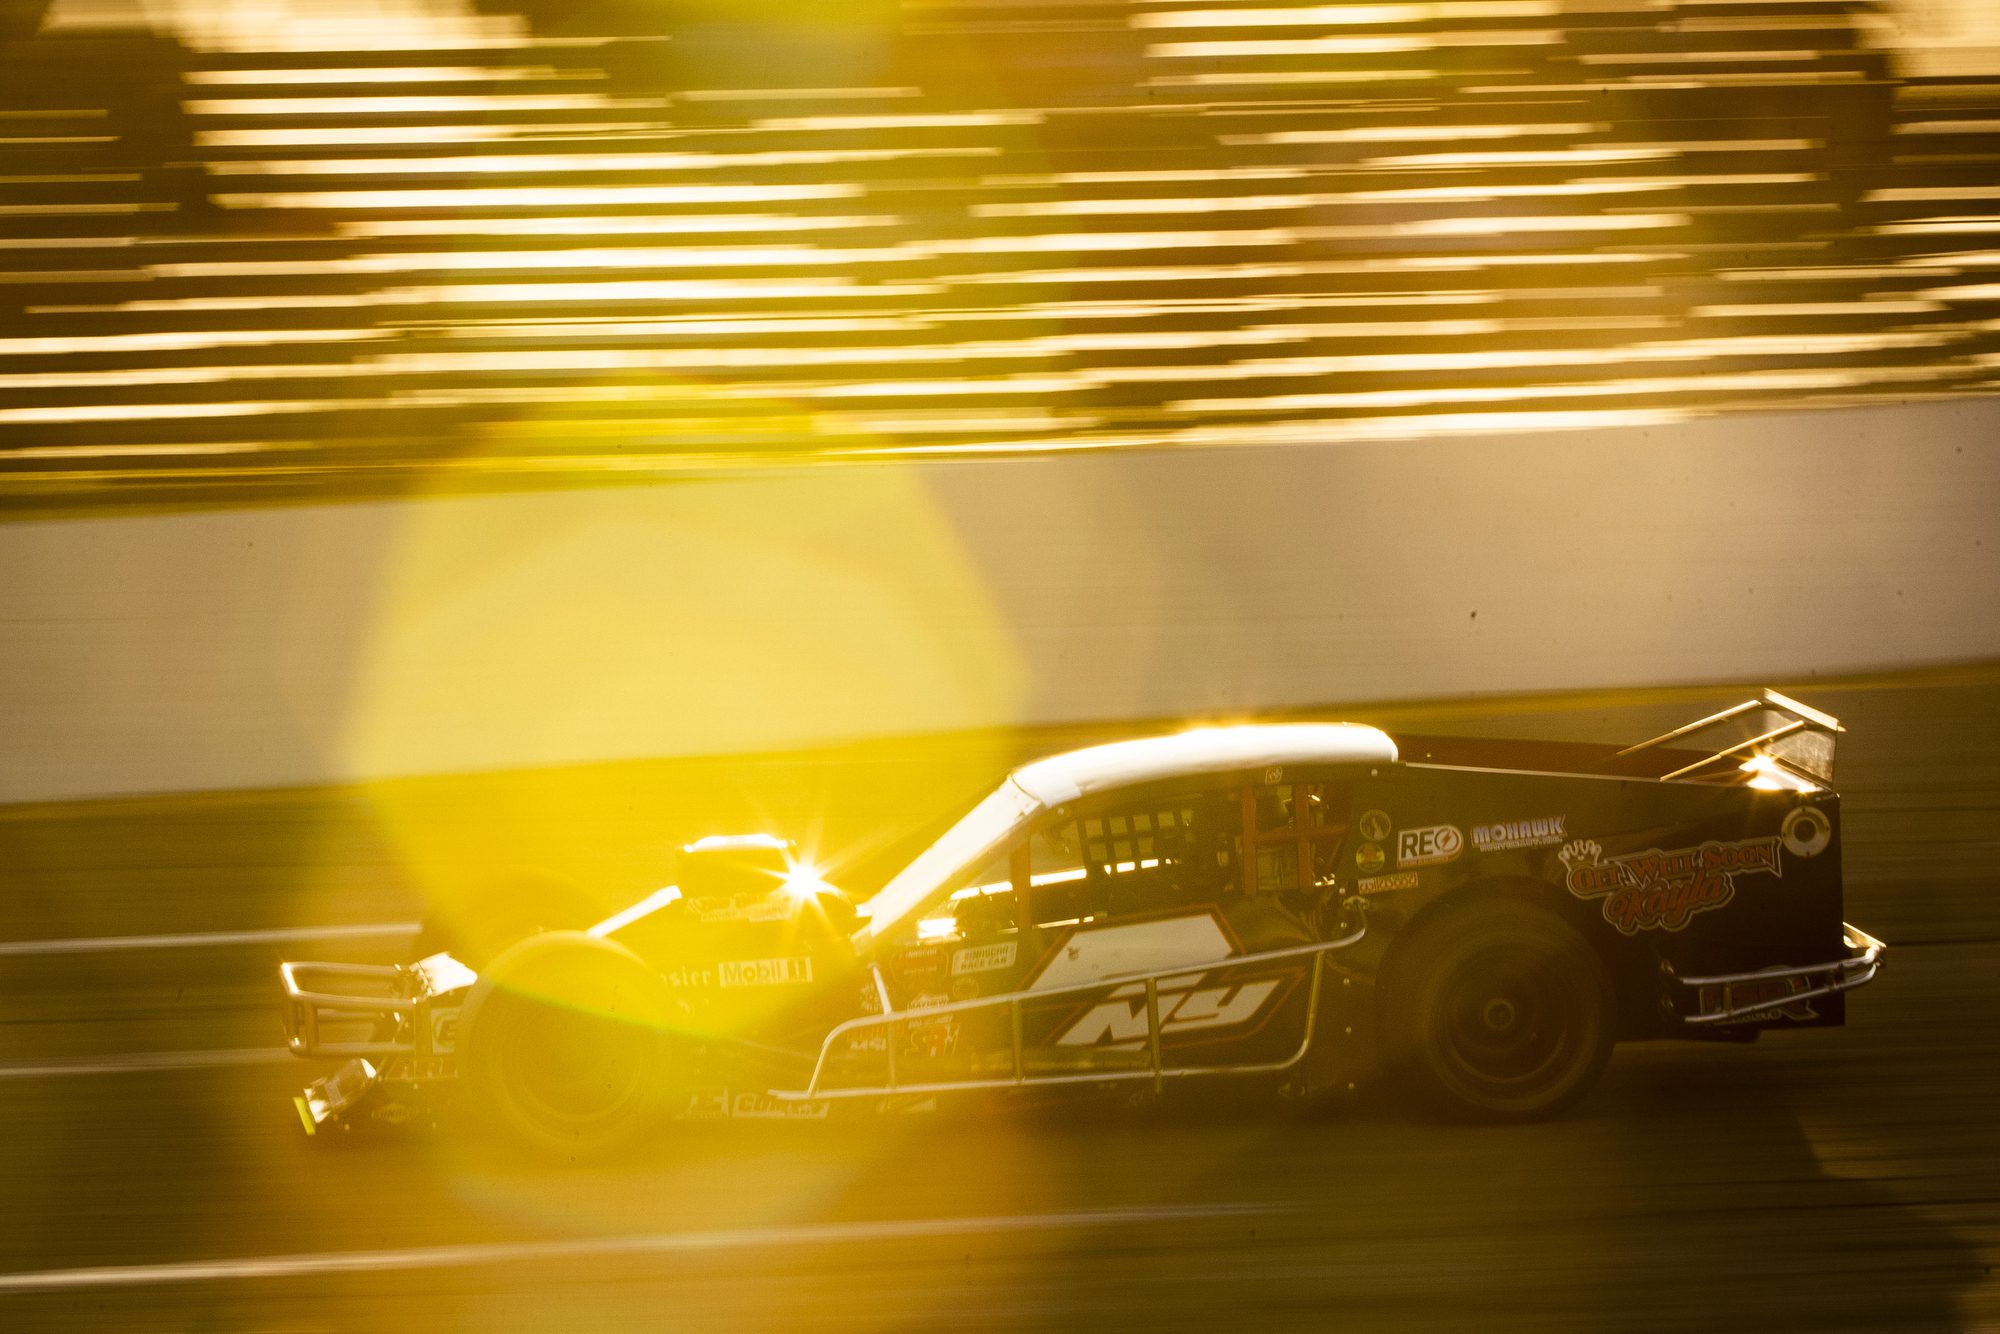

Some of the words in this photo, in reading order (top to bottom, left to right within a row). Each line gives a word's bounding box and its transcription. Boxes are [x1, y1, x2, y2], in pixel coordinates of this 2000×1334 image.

[1472, 816, 1564, 844] MOHAWK
[1703, 844, 1773, 869] SOON
[723, 960, 780, 984] Mobil
